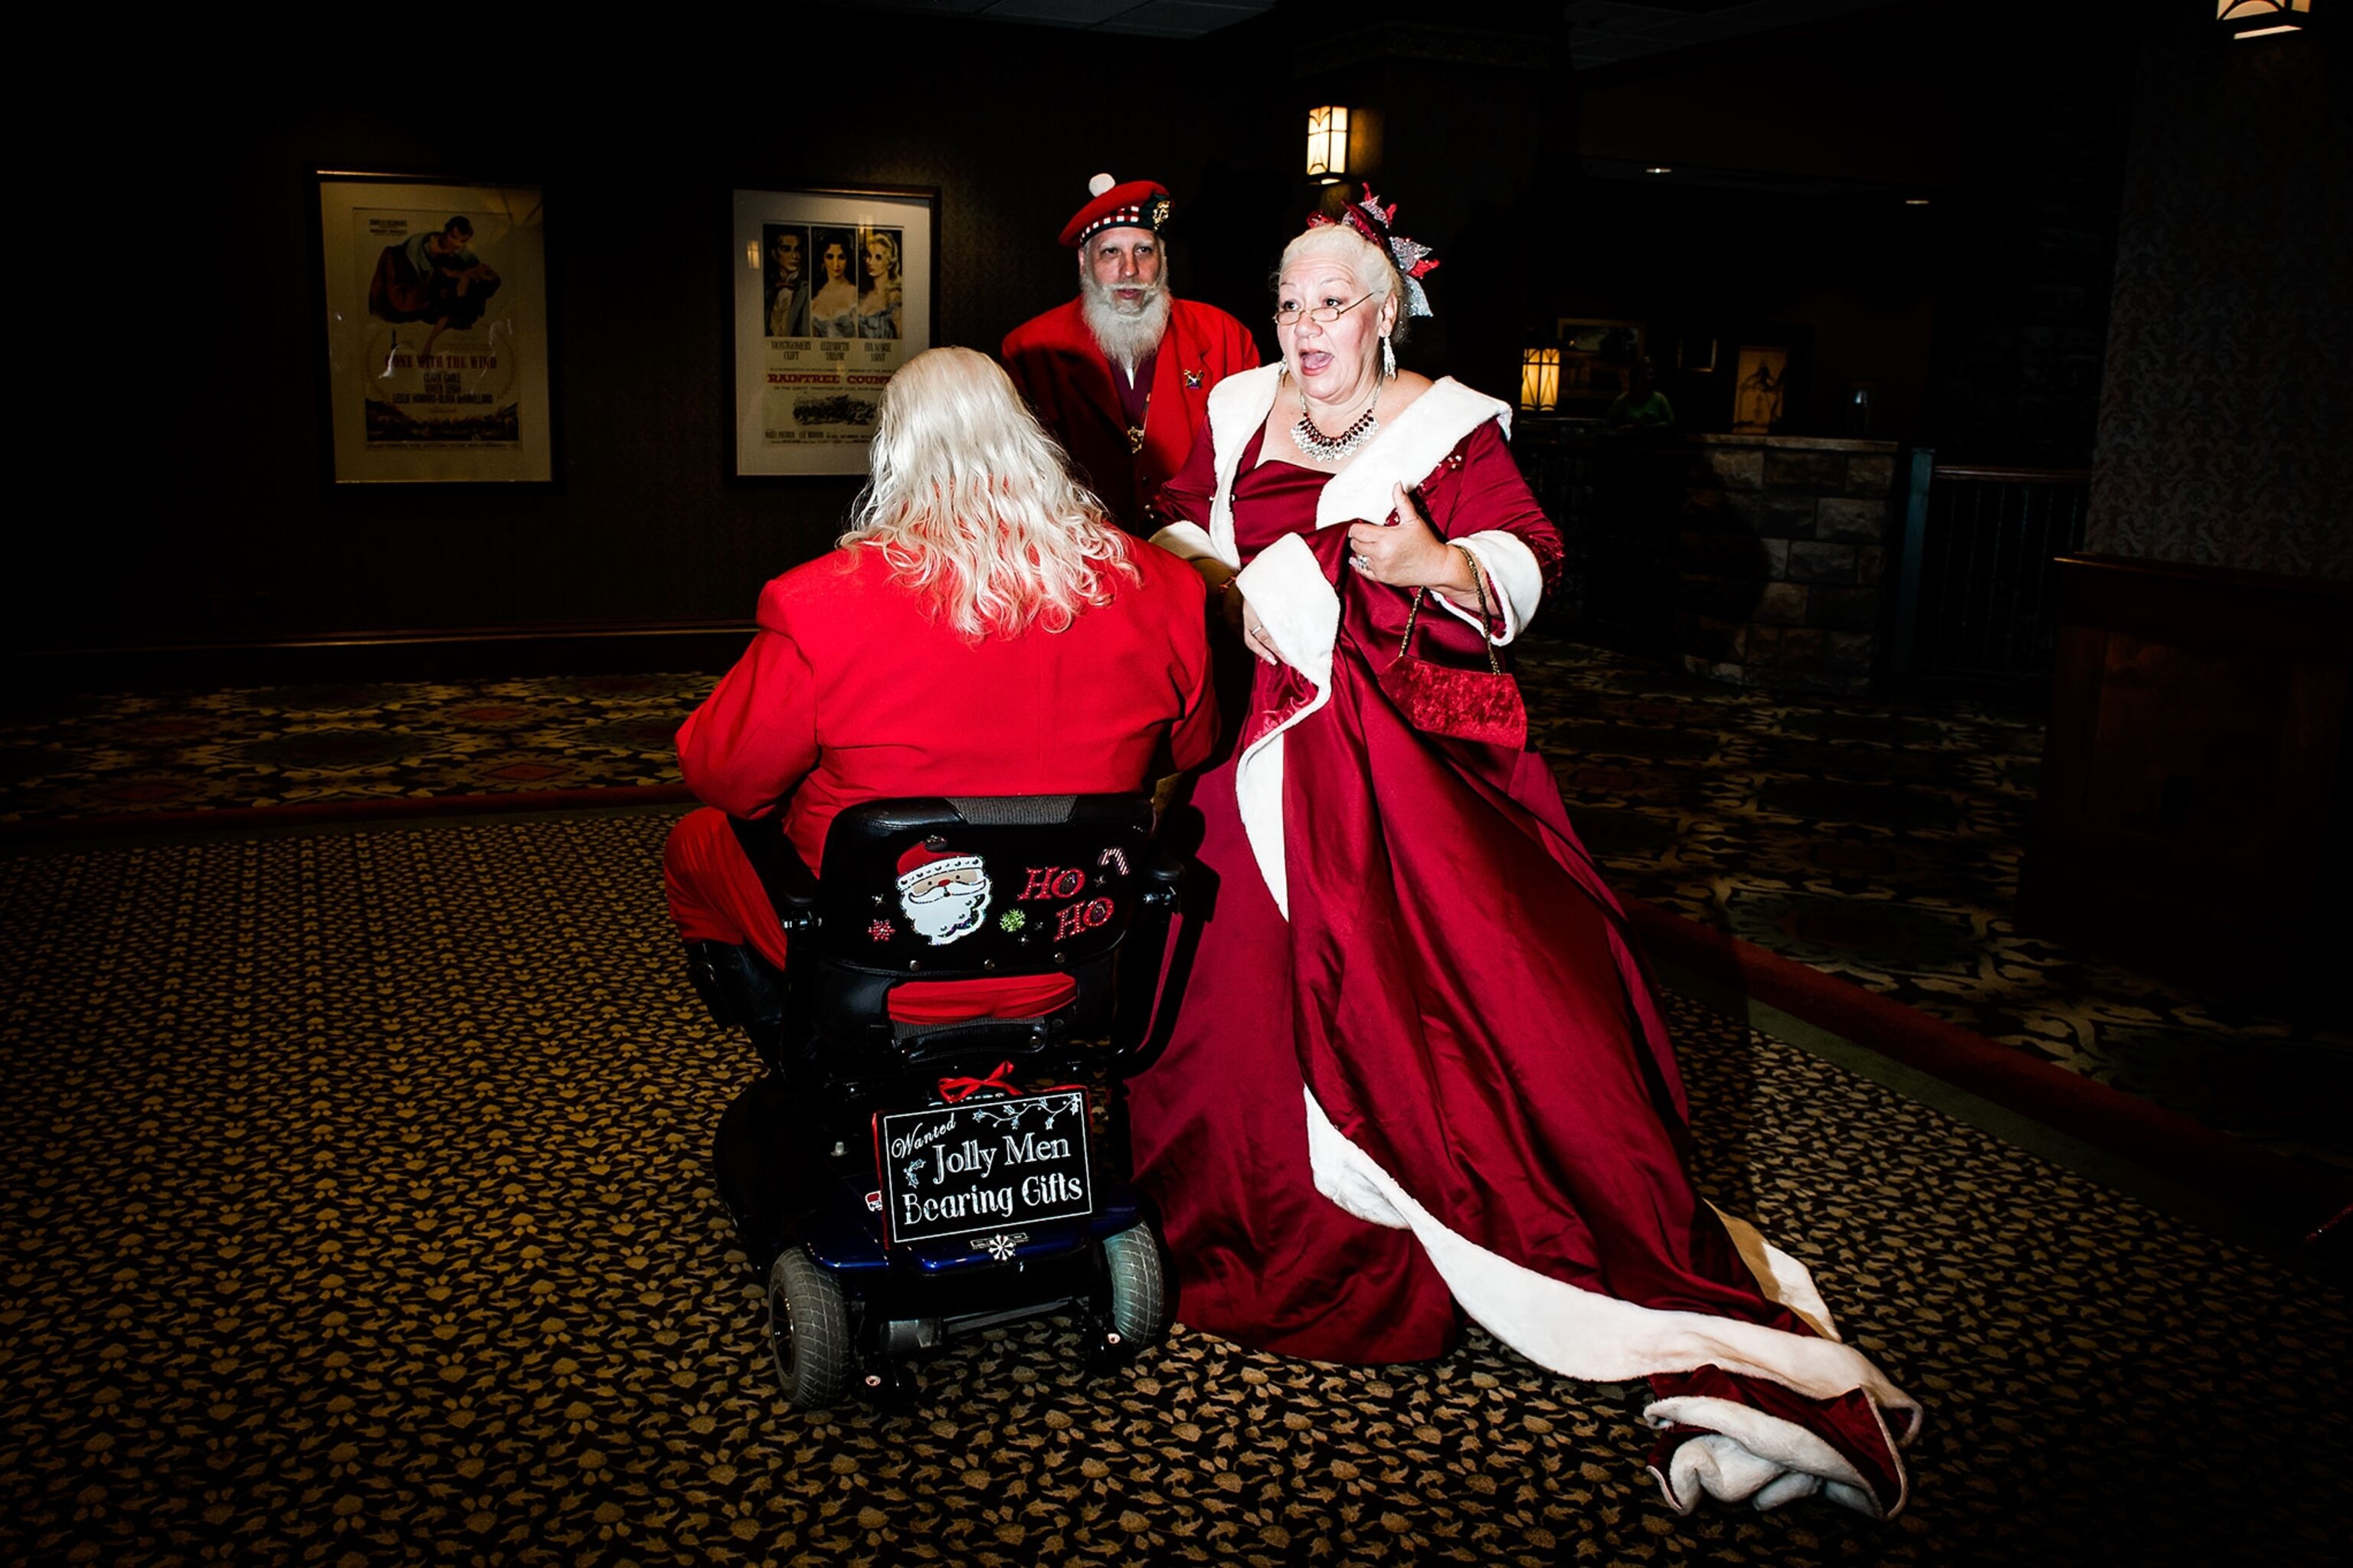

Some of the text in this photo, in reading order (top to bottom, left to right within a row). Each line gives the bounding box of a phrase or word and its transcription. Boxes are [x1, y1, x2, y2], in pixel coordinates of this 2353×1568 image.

[417, 355, 443, 369] WITH
[446, 355, 466, 369] THE
[470, 355, 497, 369] WIND
[767, 374, 840, 385] RAINTREE
[1016, 866, 1086, 902] HO
[1053, 896, 1115, 943] HO
[891, 1112, 957, 1159] Wanted
[931, 1131, 1072, 1185] Jolly Men
[902, 1173, 1083, 1226] Bearing Gifts
